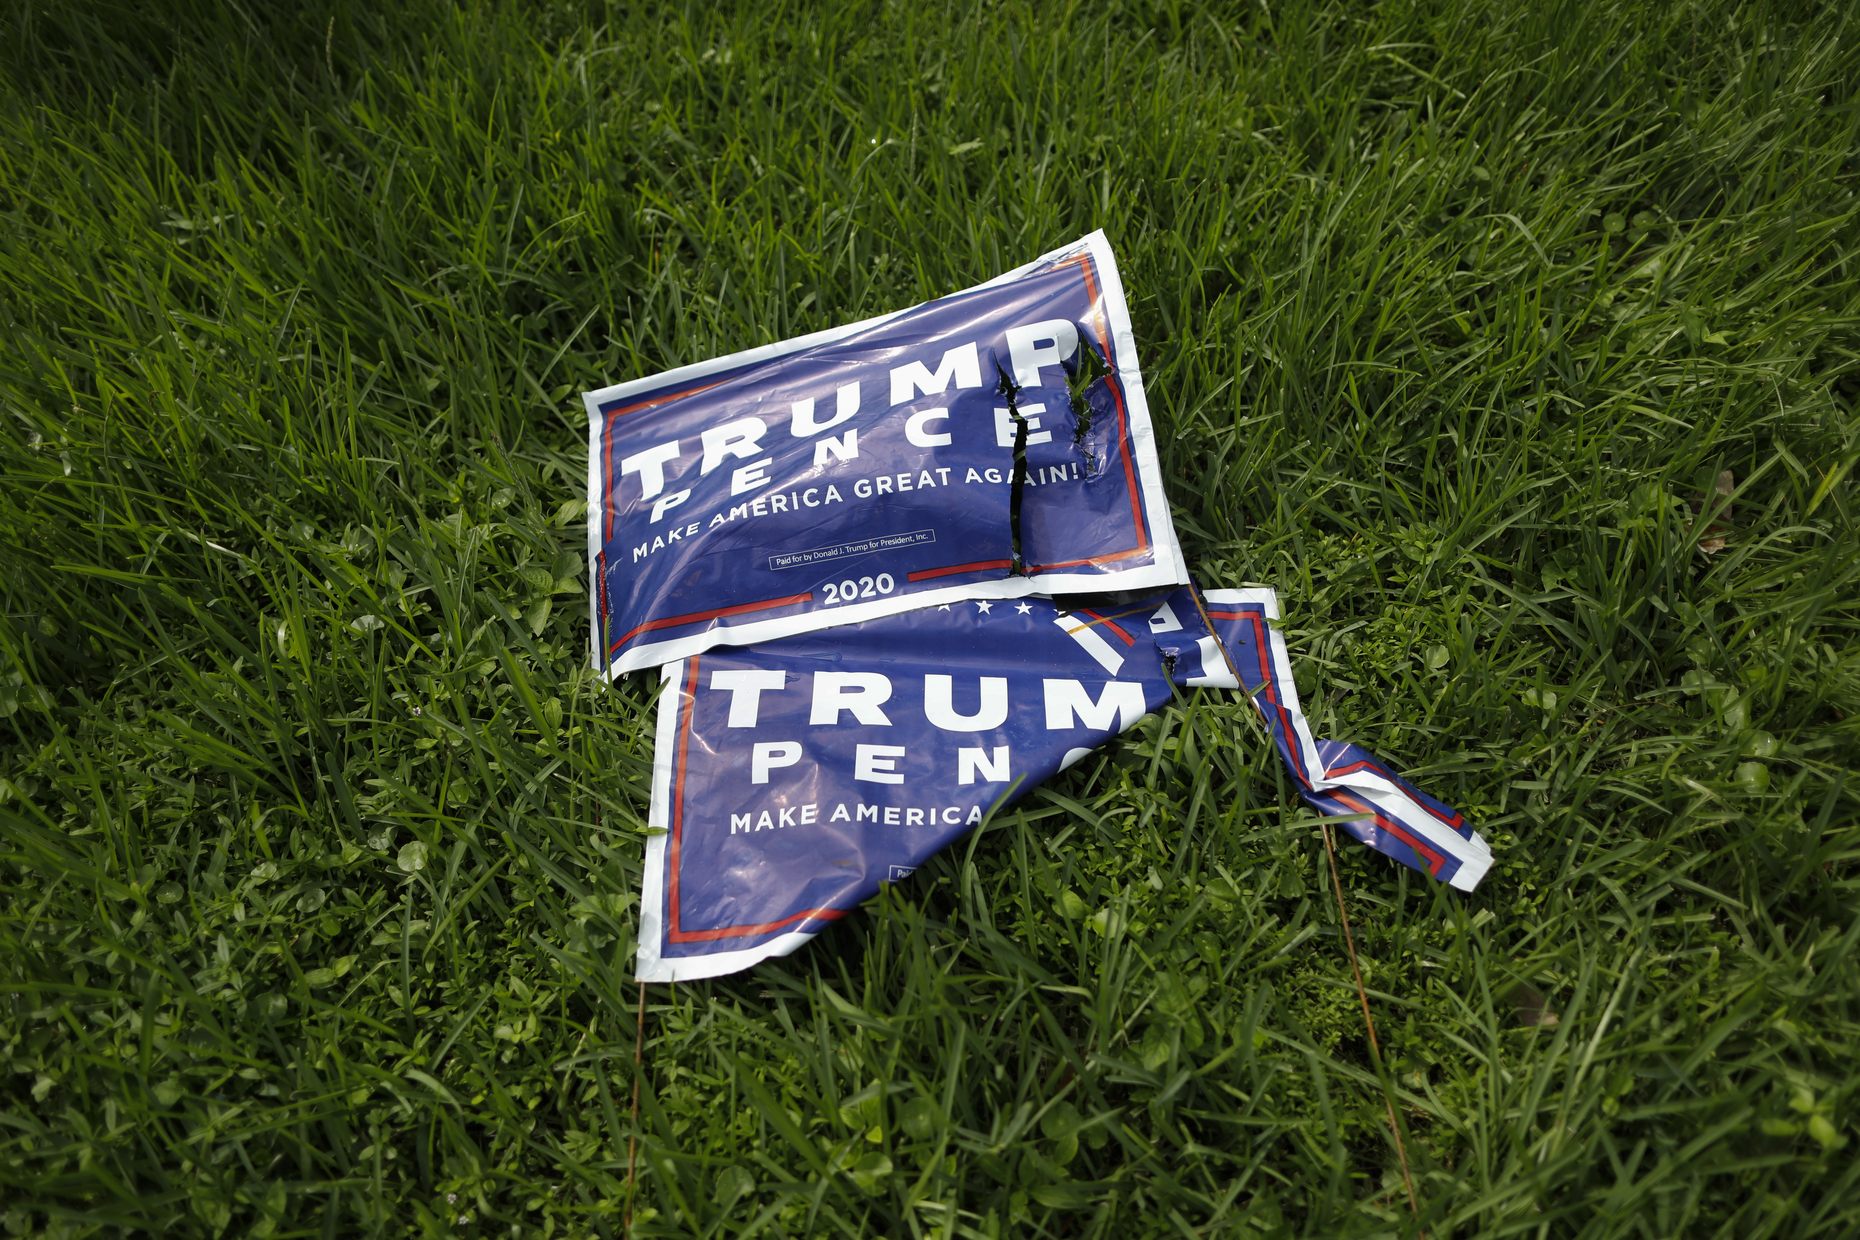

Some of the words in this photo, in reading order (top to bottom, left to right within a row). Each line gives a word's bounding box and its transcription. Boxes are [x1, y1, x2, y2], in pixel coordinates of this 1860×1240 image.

[622, 318, 1079, 502] TRUMP
[650, 402, 1053, 524] PENCE
[633, 521, 700, 564] MAKE
[709, 484, 844, 528] AMERICA
[854, 467, 952, 499] GREAT
[965, 462, 1079, 487] AGAIN!
[776, 557, 792, 567] Paid
[792, 555, 802, 563] for
[803, 553, 812, 563] by
[813, 547, 838, 560] Donald
[839, 547, 845, 555] J.
[846, 543, 869, 555] Trump
[869, 540, 880, 549] for
[880, 535, 915, 547] President,
[916, 533, 929, 542] Inc.
[822, 573, 895, 605] 2020
[751, 741, 1093, 786] PEN
[730, 804, 818, 835] MAKE
[830, 803, 982, 826] AMERICA
